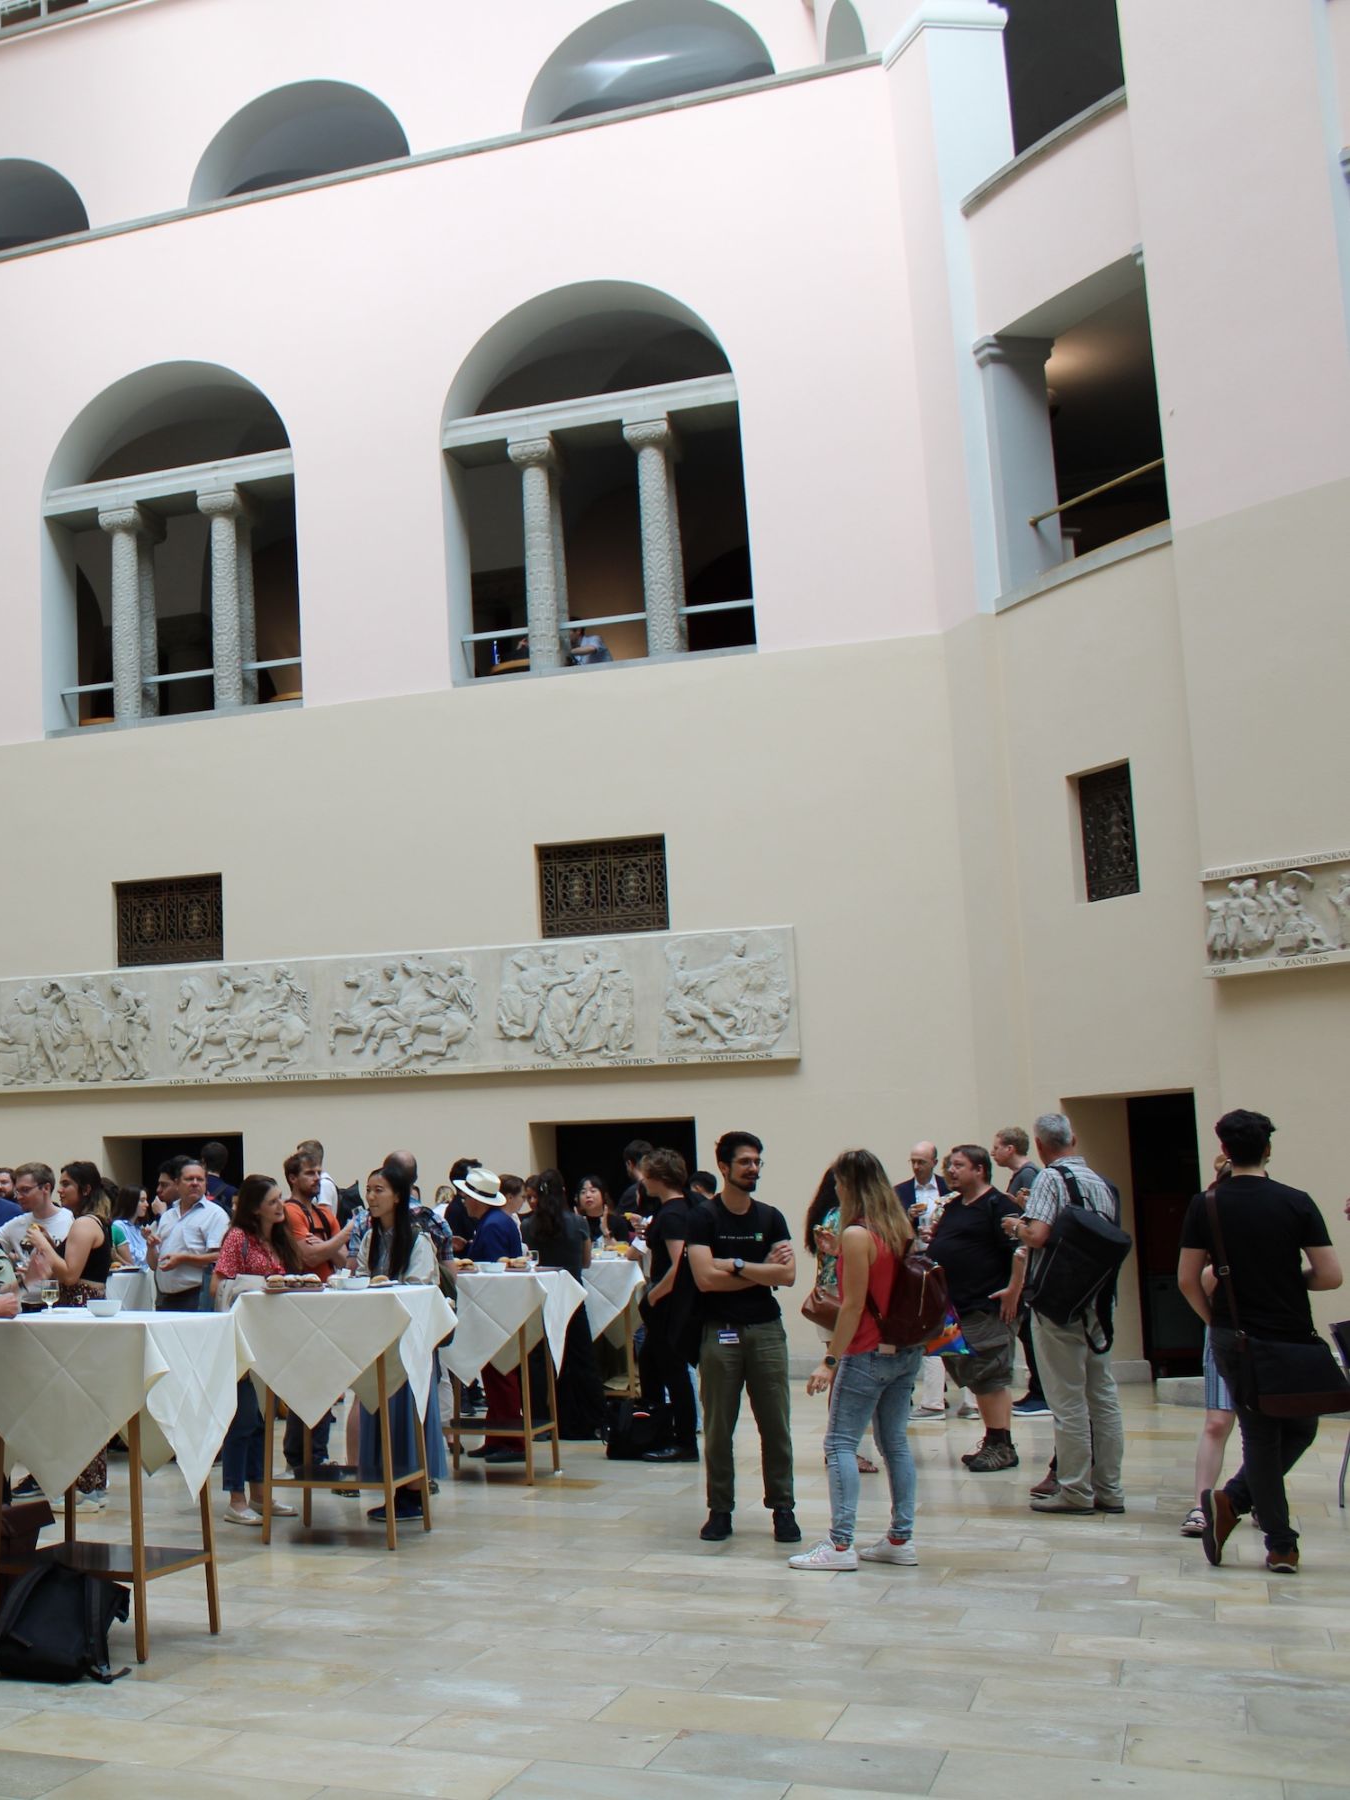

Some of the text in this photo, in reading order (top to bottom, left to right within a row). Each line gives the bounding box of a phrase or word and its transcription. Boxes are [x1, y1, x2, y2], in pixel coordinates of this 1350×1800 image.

[567, 1061, 596, 1069] VOM
[667, 1056, 688, 1064] DES
[699, 1051, 774, 1063] PARTHENONS
[227, 1074, 253, 1083] VOM
[360, 1068, 428, 1078] PARTHENONS
